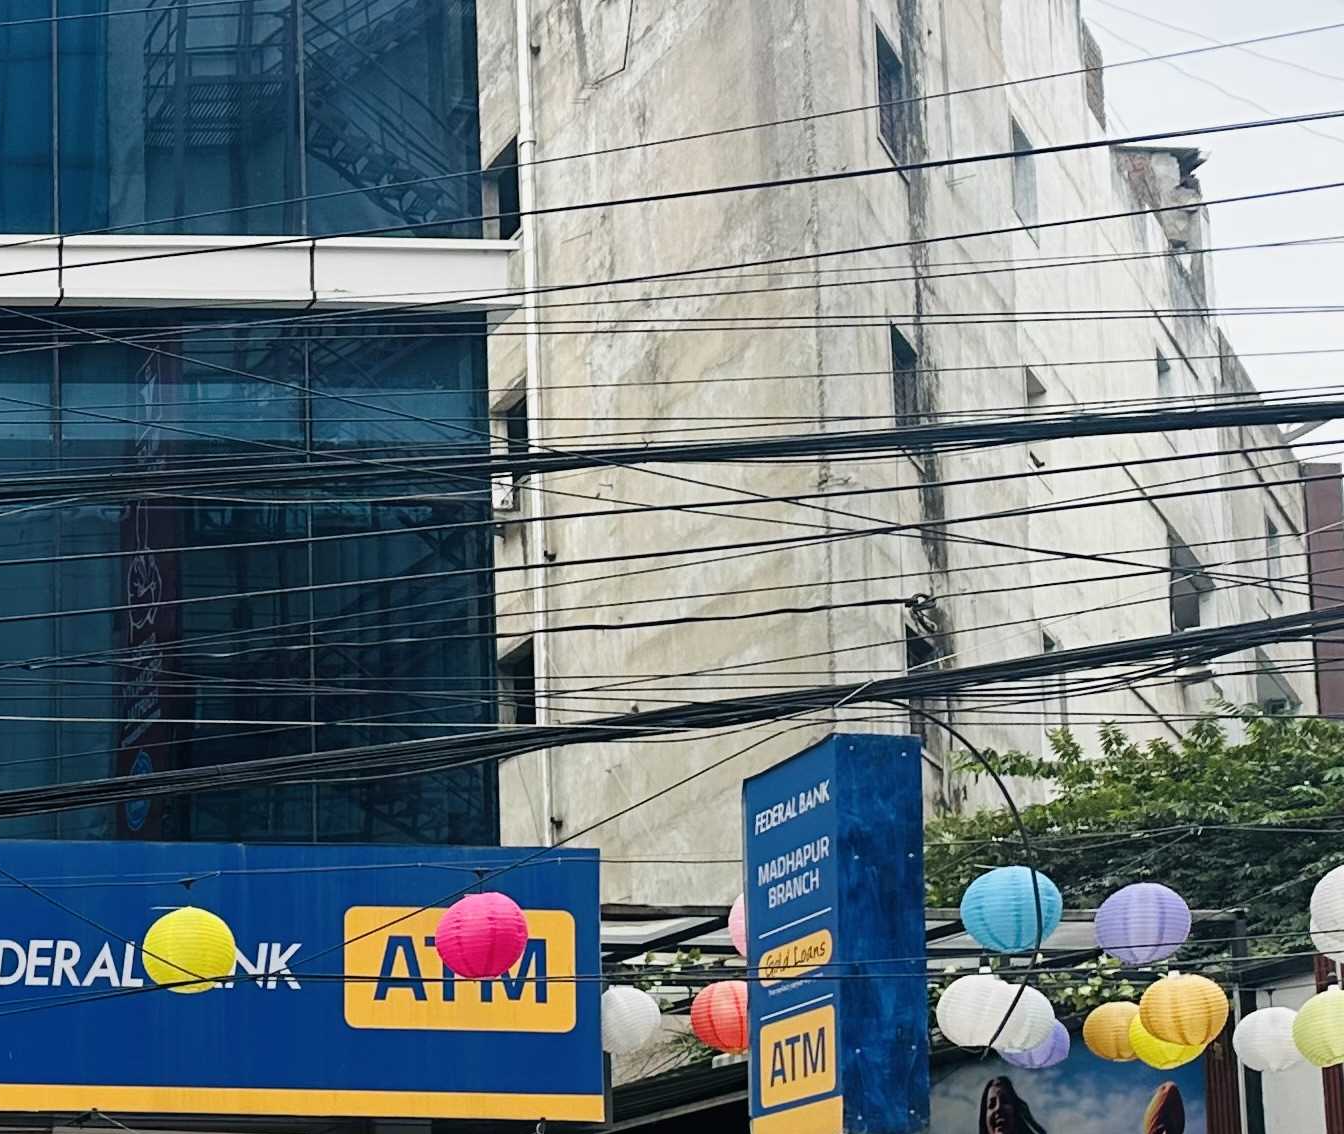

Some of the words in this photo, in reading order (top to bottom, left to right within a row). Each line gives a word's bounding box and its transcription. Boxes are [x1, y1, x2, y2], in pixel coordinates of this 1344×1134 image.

[754, 796, 798, 836] FEDERAL
[799, 779, 831, 816] BANK
[757, 834, 831, 888] MADHAPUR
[768, 867, 821, 910] BRANCH
[765, 948, 791, 979] Gold
[793, 940, 827, 967] Loans
[769, 1025, 827, 1090] ATM
